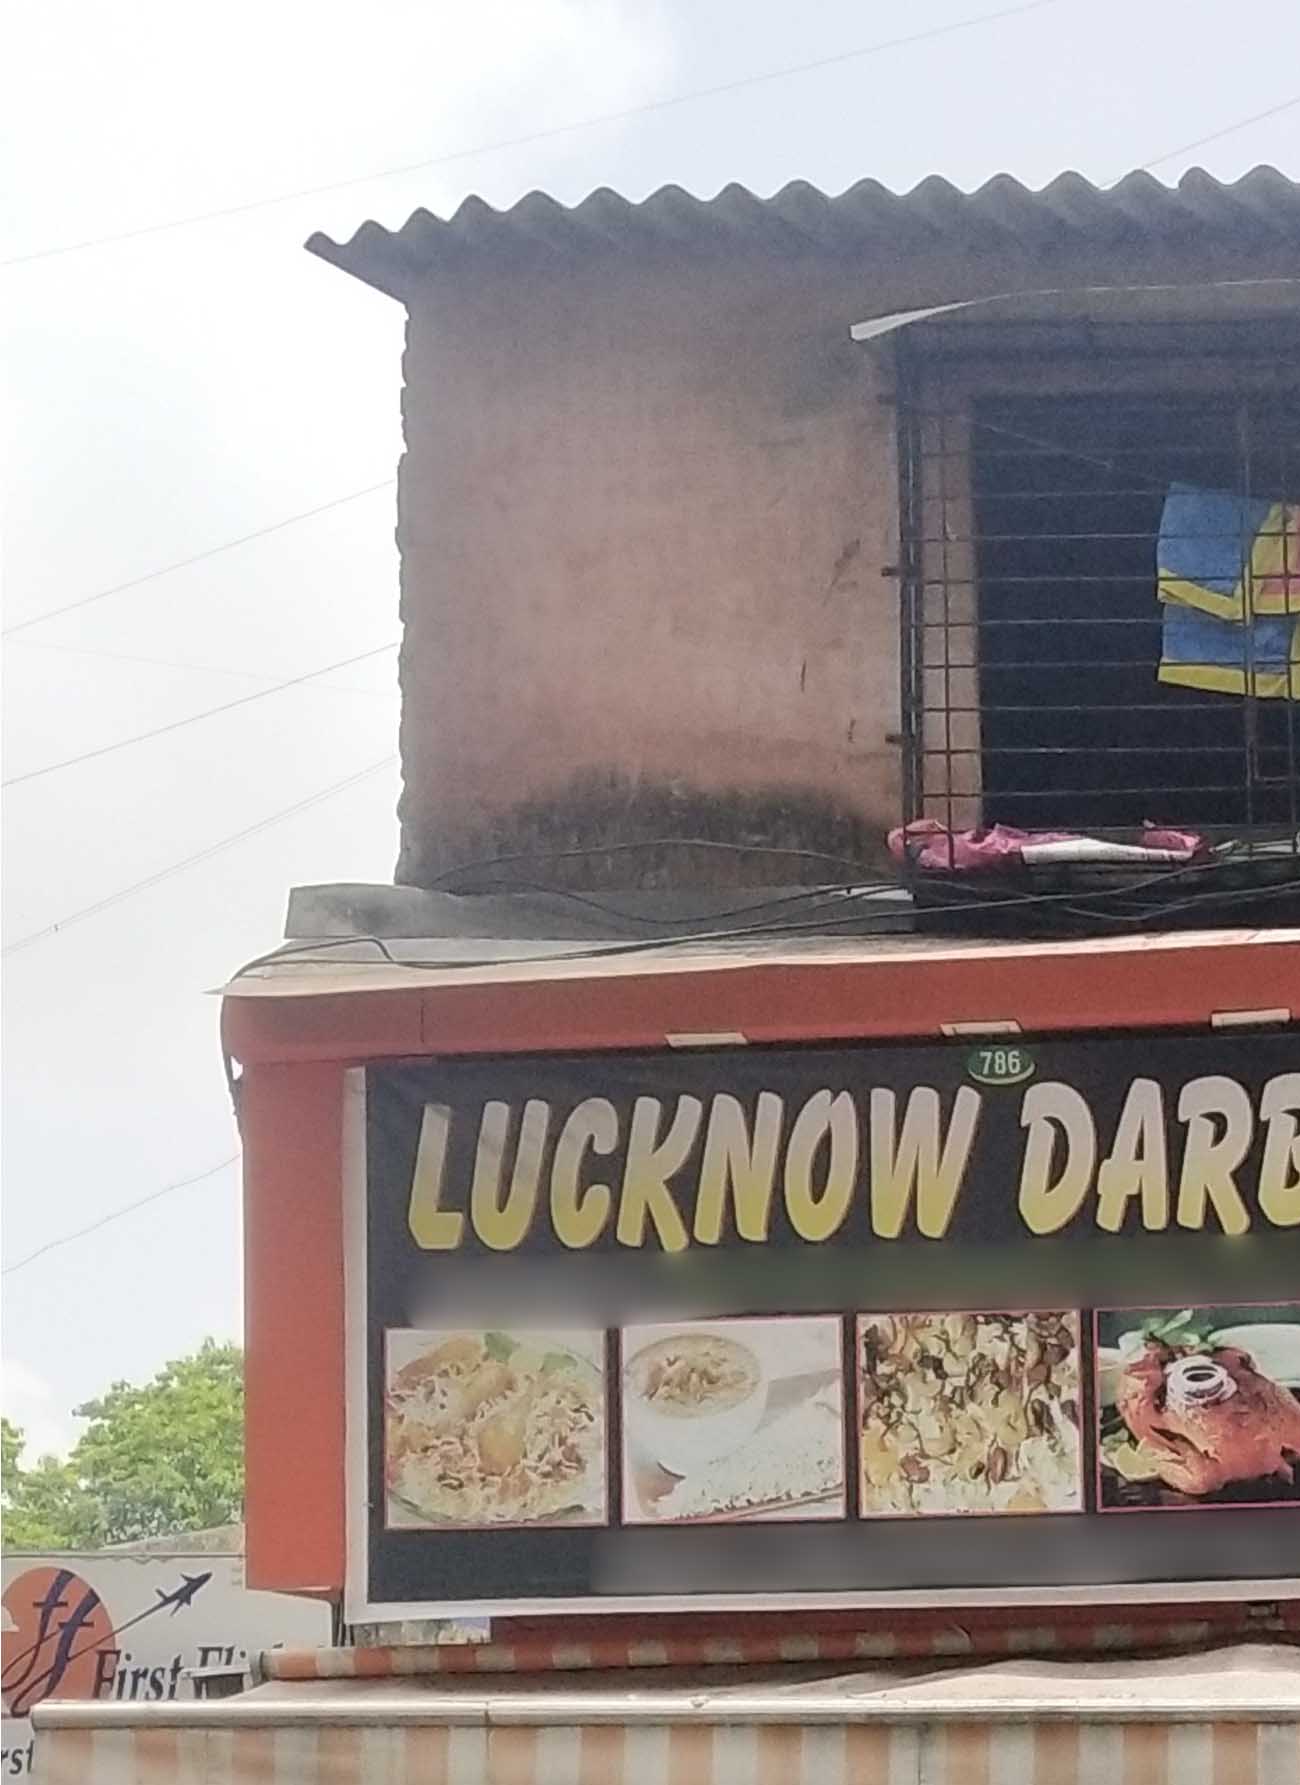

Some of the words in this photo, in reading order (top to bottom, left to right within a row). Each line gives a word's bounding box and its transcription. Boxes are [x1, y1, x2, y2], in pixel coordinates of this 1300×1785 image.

[979, 1051, 1022, 1075] 786
[408, 1085, 982, 1254] LUCKNOW
[91, 1648, 184, 1701] First
